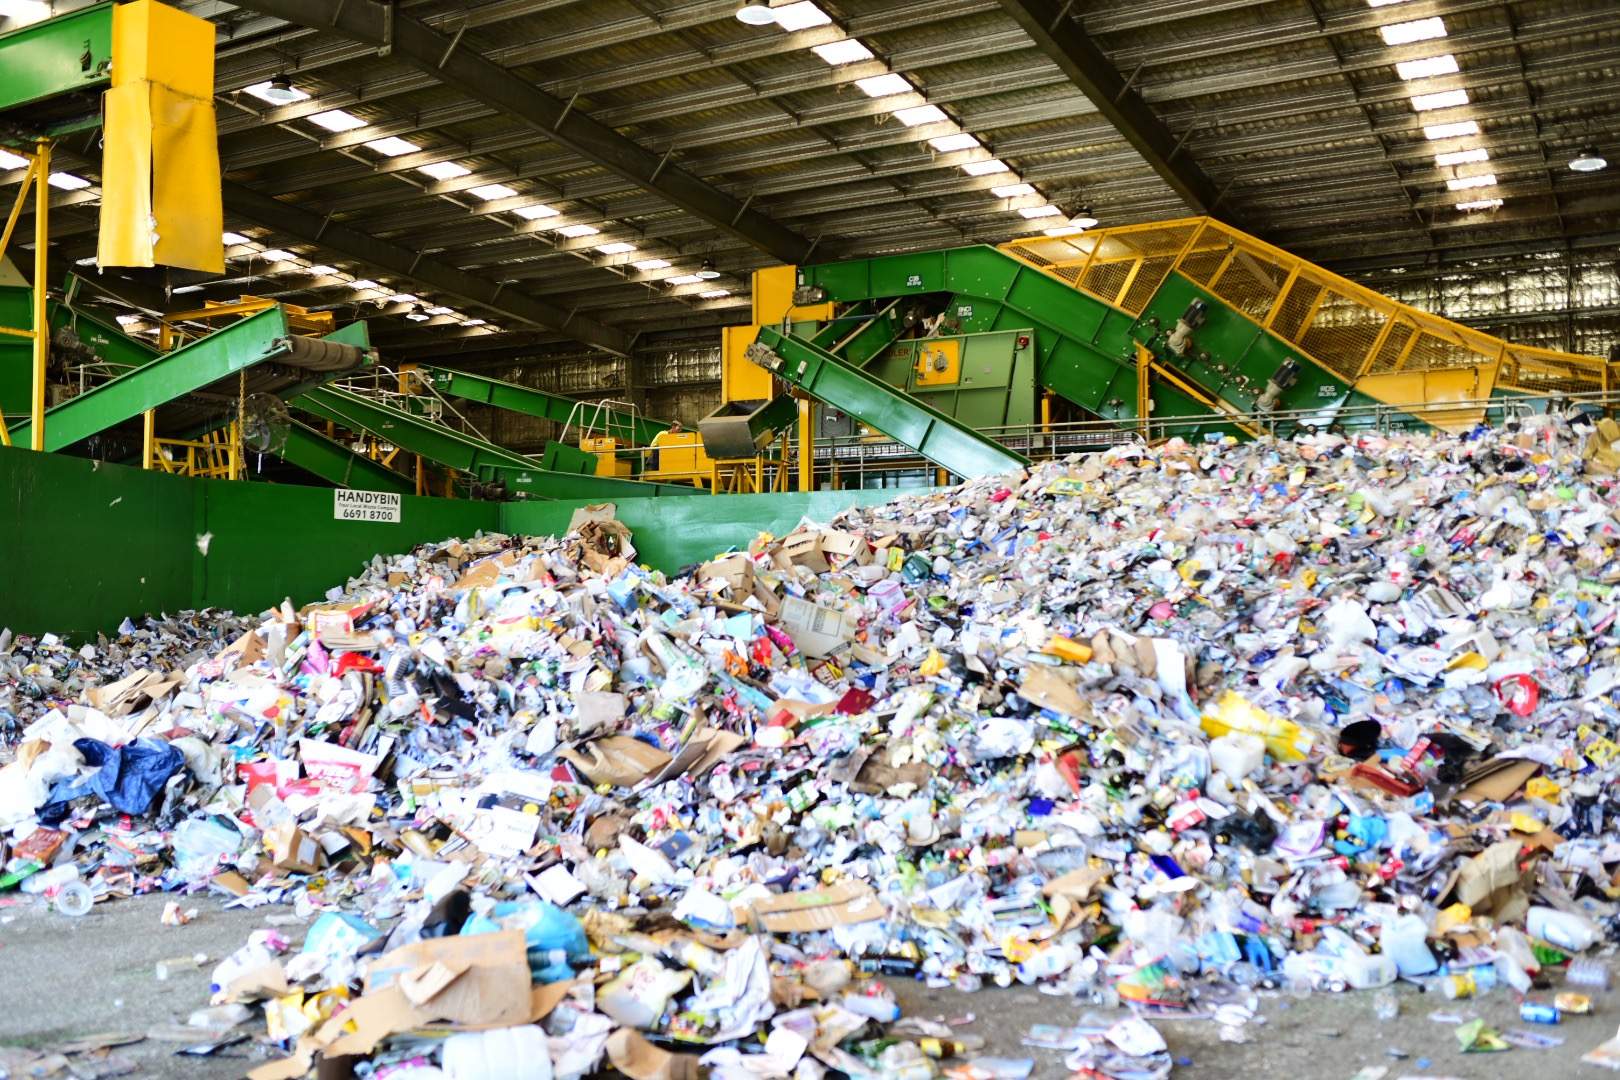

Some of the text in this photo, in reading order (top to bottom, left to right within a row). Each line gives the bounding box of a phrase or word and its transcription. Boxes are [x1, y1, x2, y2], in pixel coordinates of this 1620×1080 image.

[337, 490, 399, 506] HANDYBIN
[343, 509, 393, 521] 6691 8700
